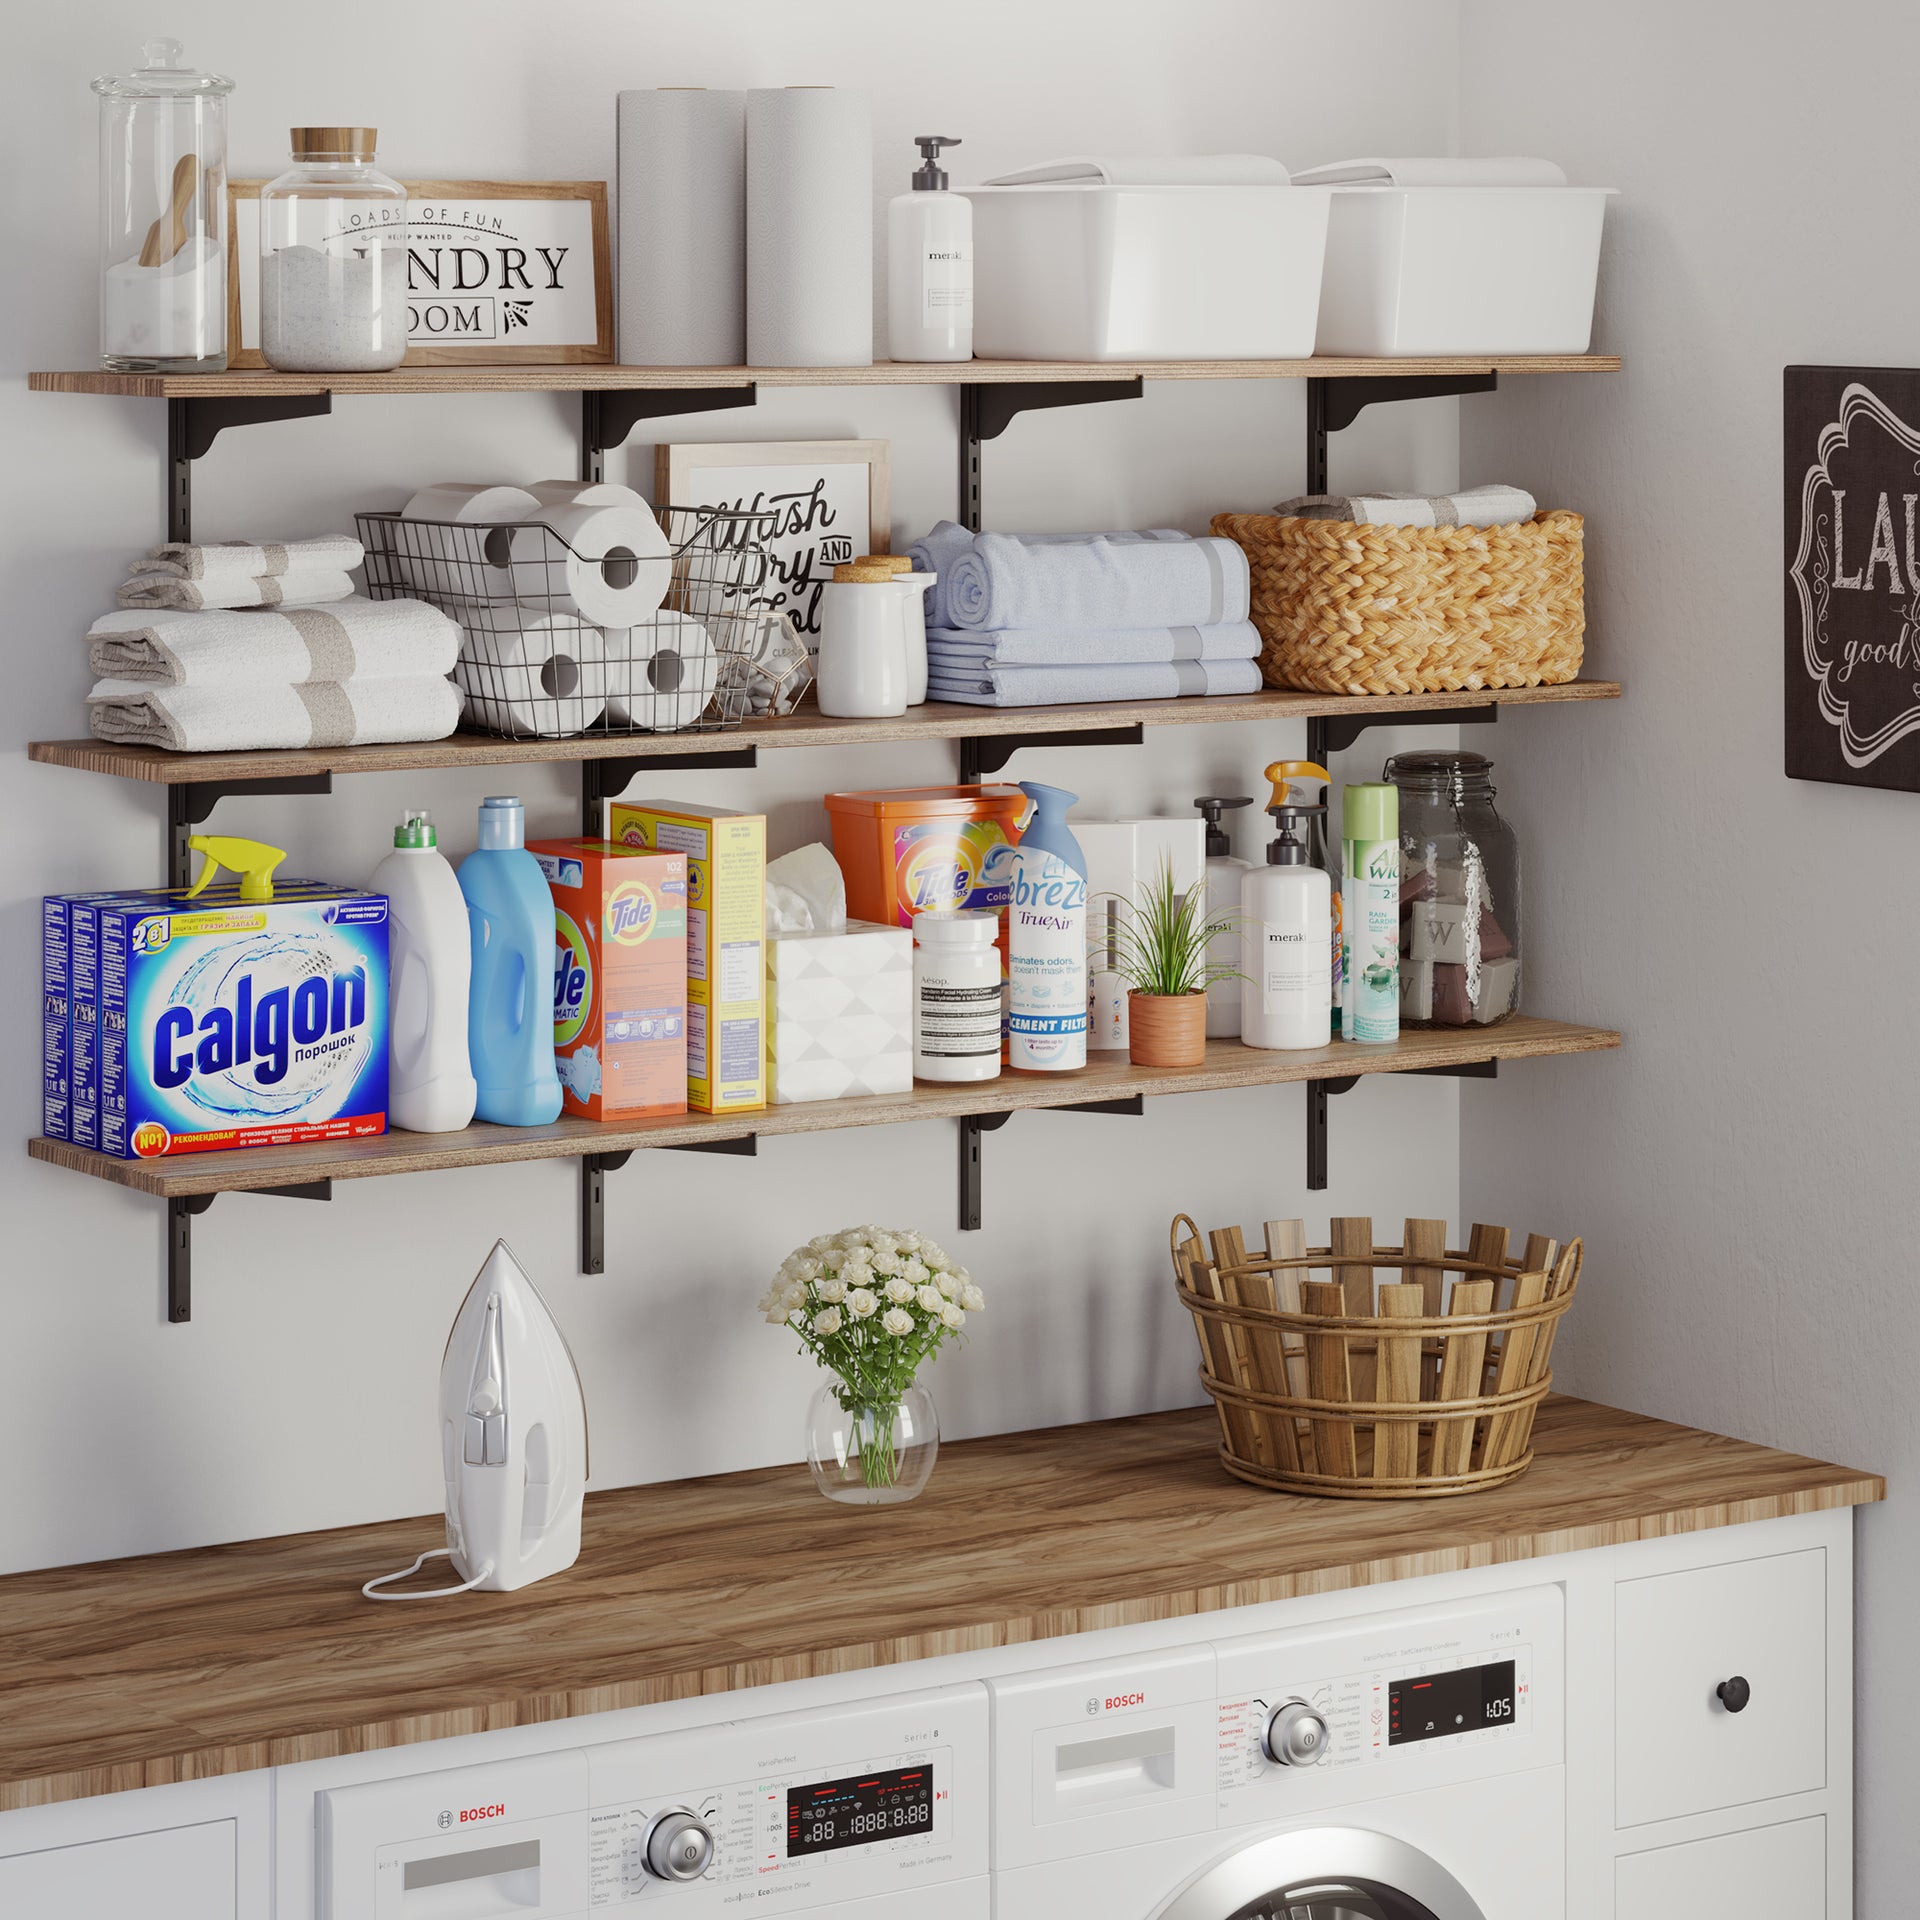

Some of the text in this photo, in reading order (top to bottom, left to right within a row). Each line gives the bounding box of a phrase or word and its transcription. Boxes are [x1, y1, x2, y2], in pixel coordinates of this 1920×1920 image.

[423, 207, 447, 221] OF
[463, 211, 503, 230] FUN
[697, 478, 836, 554] Wash
[819, 541, 852, 561] AND
[722, 541, 820, 596] Dry
[1838, 622, 1911, 683] good
[666, 861, 683, 872] 102
[913, 863, 969, 906] Tide
[1383, 889, 1391, 899] 2
[611, 896, 652, 936] Tide
[1205, 923, 1232, 932] eraki
[554, 949, 586, 1007] de
[1041, 966, 1065, 975] mask
[153, 963, 366, 1089] Calgon
[1010, 1016, 1087, 1032] CEMENT FILTE
[294, 1033, 356, 1063] Порошок
[1490, 1631, 1511, 1641] Serie
[1105, 1692, 1144, 1710] BOSCH
[1486, 1697, 1511, 1719] 1:05
[904, 1729, 939, 1743] Serie 8
[757, 1755, 797, 1767] VarioPerfect
[758, 1780, 793, 1792] EcoPerfect
[459, 1804, 505, 1822] BOSCH
[758, 1859, 801, 1874] SpeedPerfect
[899, 1861, 916, 1869] Made
[926, 1853, 953, 1866] Germany
[757, 1884, 794, 1897] EcoSilence
[794, 1880, 811, 1891] Drive
